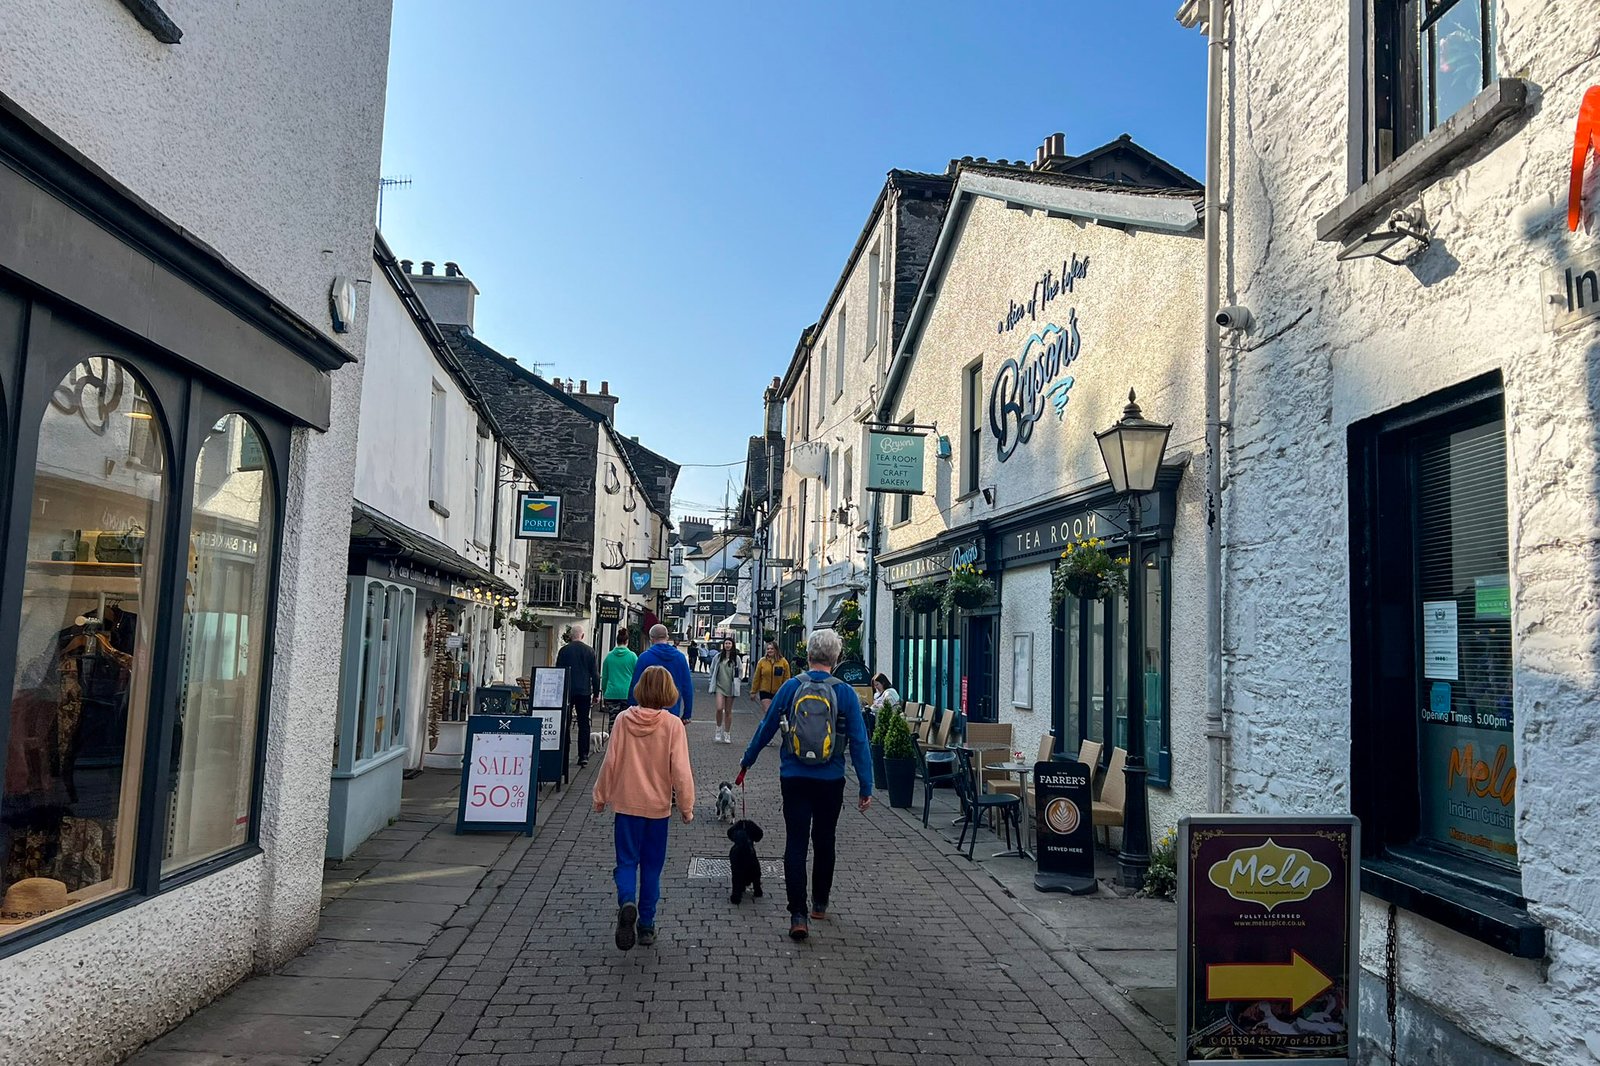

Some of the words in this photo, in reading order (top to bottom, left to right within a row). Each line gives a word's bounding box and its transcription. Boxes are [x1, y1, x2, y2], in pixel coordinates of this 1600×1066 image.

[1027, 281, 1038, 321] of
[989, 307, 1080, 463] Bryson's
[892, 455, 917, 463] ROOM
[880, 477, 911, 487] BAKERY
[883, 469, 908, 477] CRAFT
[524, 519, 555, 528] PORTO
[1017, 531, 1041, 551] TEA
[1051, 514, 1097, 543] ROOM
[891, 563, 912, 580] CRAFT
[916, 556, 947, 574] BAKERY
[1421, 708, 1449, 722] Opening
[1451, 711, 1473, 724] Times
[1476, 713, 1507, 729] 5.00pm
[477, 756, 525, 776] SALE
[1039, 775, 1086, 785] FARRER'S
[510, 798, 525, 808] off
[1448, 799, 1479, 821] Indian
[1229, 854, 1311, 888] Mela
[1220, 1037, 1255, 1045] 015394
[1258, 1036, 1287, 1045] 45777
[1302, 1036, 1331, 1045] 45781
